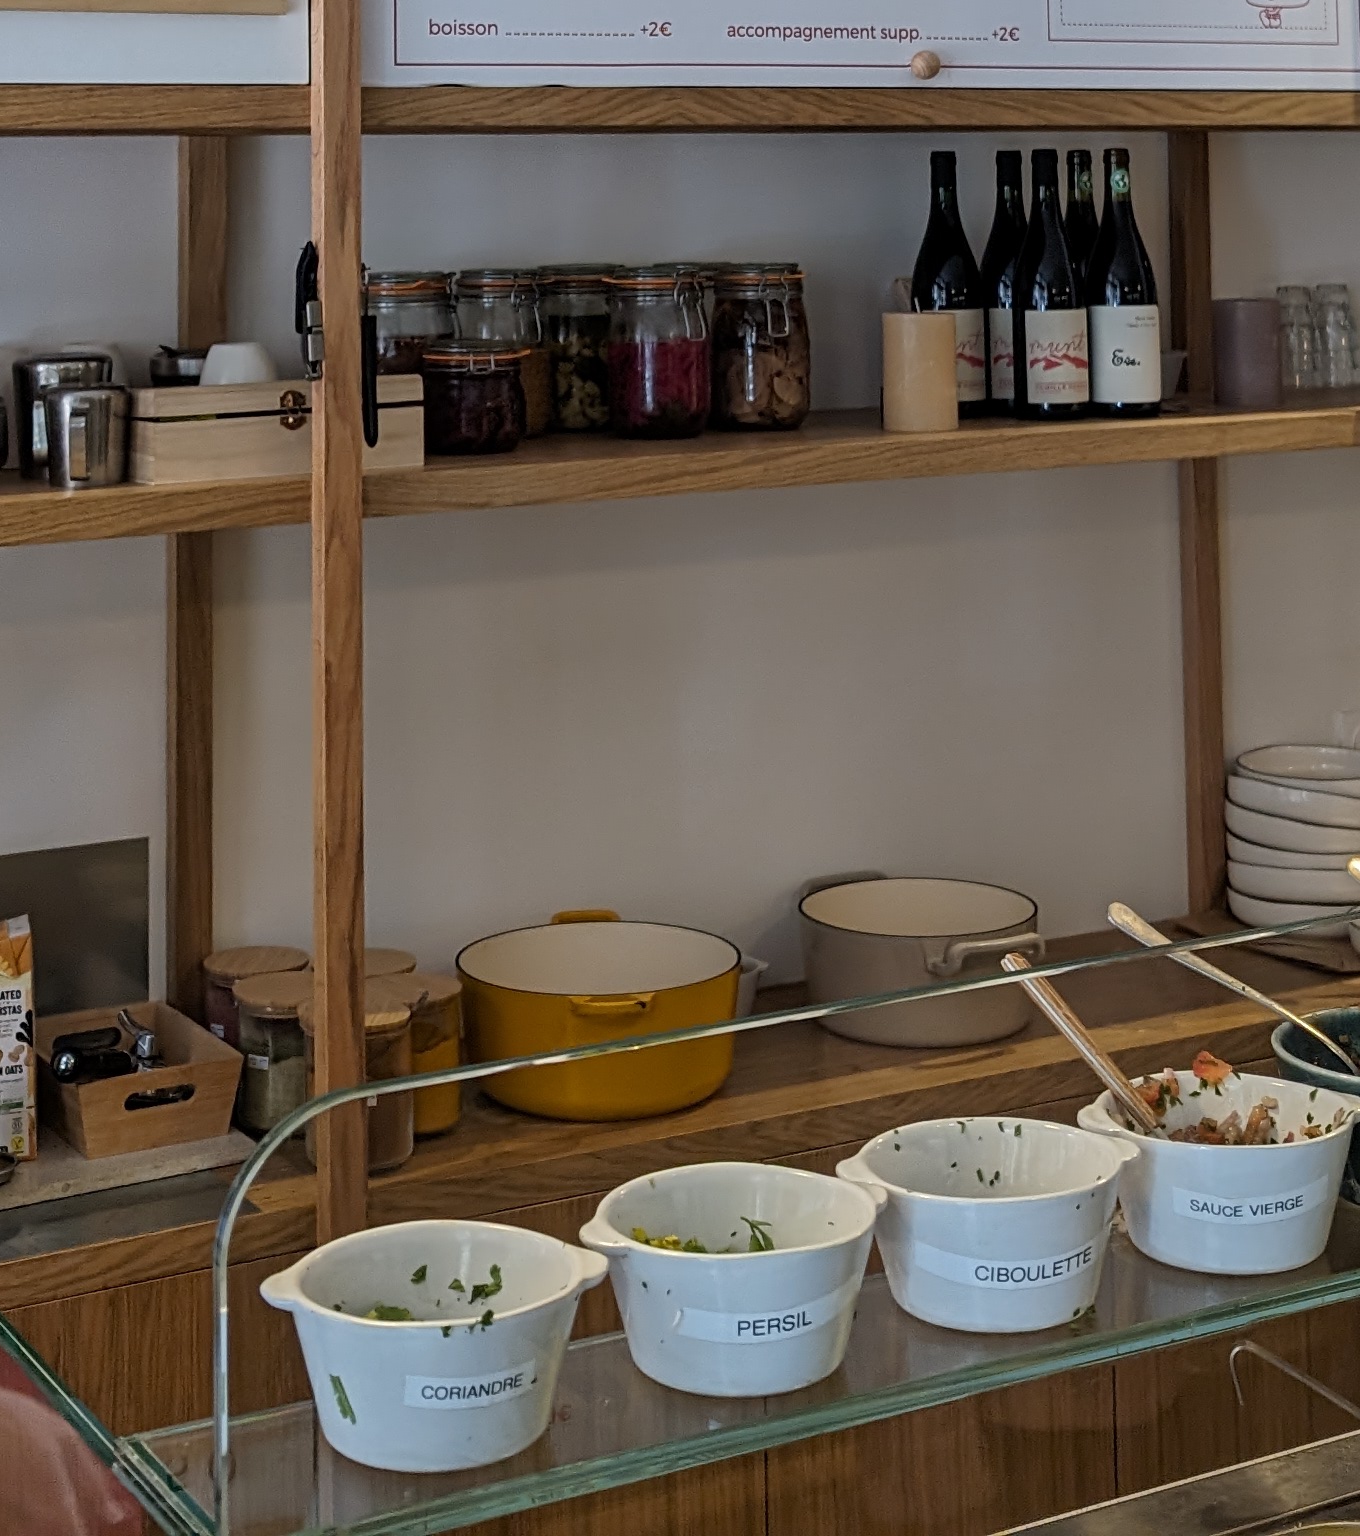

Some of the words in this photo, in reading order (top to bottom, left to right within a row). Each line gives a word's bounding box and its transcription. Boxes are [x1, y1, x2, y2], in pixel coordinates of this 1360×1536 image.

[428, 19, 499, 36] boisson
[640, 21, 673, 38] +2€
[726, 24, 876, 42] accompagnement
[991, 26, 1020, 43] +2€
[5, 1065, 23, 1076] OATS
[1190, 1199, 1244, 1218] SAUCE
[1248, 1195, 1304, 1217] VIERGE
[974, 1246, 1093, 1283] CIBOULETTE
[737, 1310, 812, 1339] PERSIL
[420, 1372, 524, 1401] CORIANDRE
